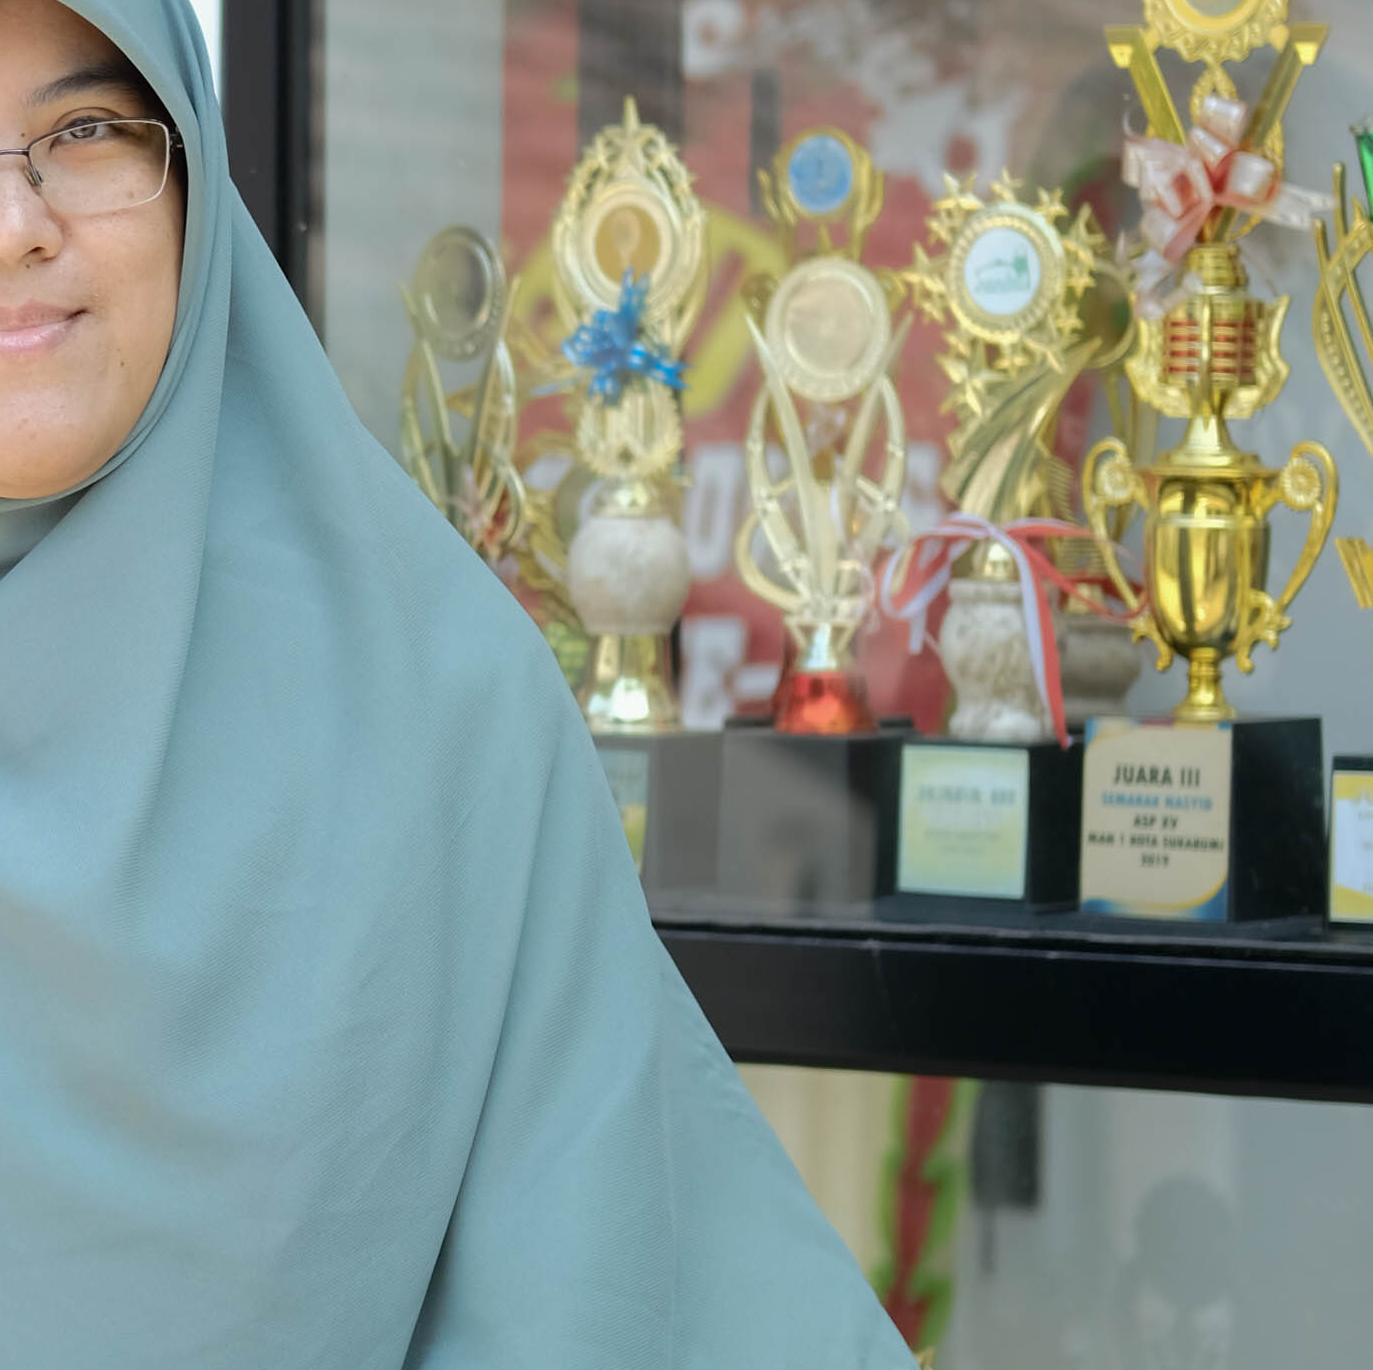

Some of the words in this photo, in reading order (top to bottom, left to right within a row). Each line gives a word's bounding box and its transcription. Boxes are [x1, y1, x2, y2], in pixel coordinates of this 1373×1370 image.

[1114, 766, 1173, 786] JUARA
[1180, 768, 1201, 787] III
[1133, 814, 1157, 827] ASP
[1129, 834, 1158, 847] KOTA
[1163, 836, 1224, 851] SUKABUMI
